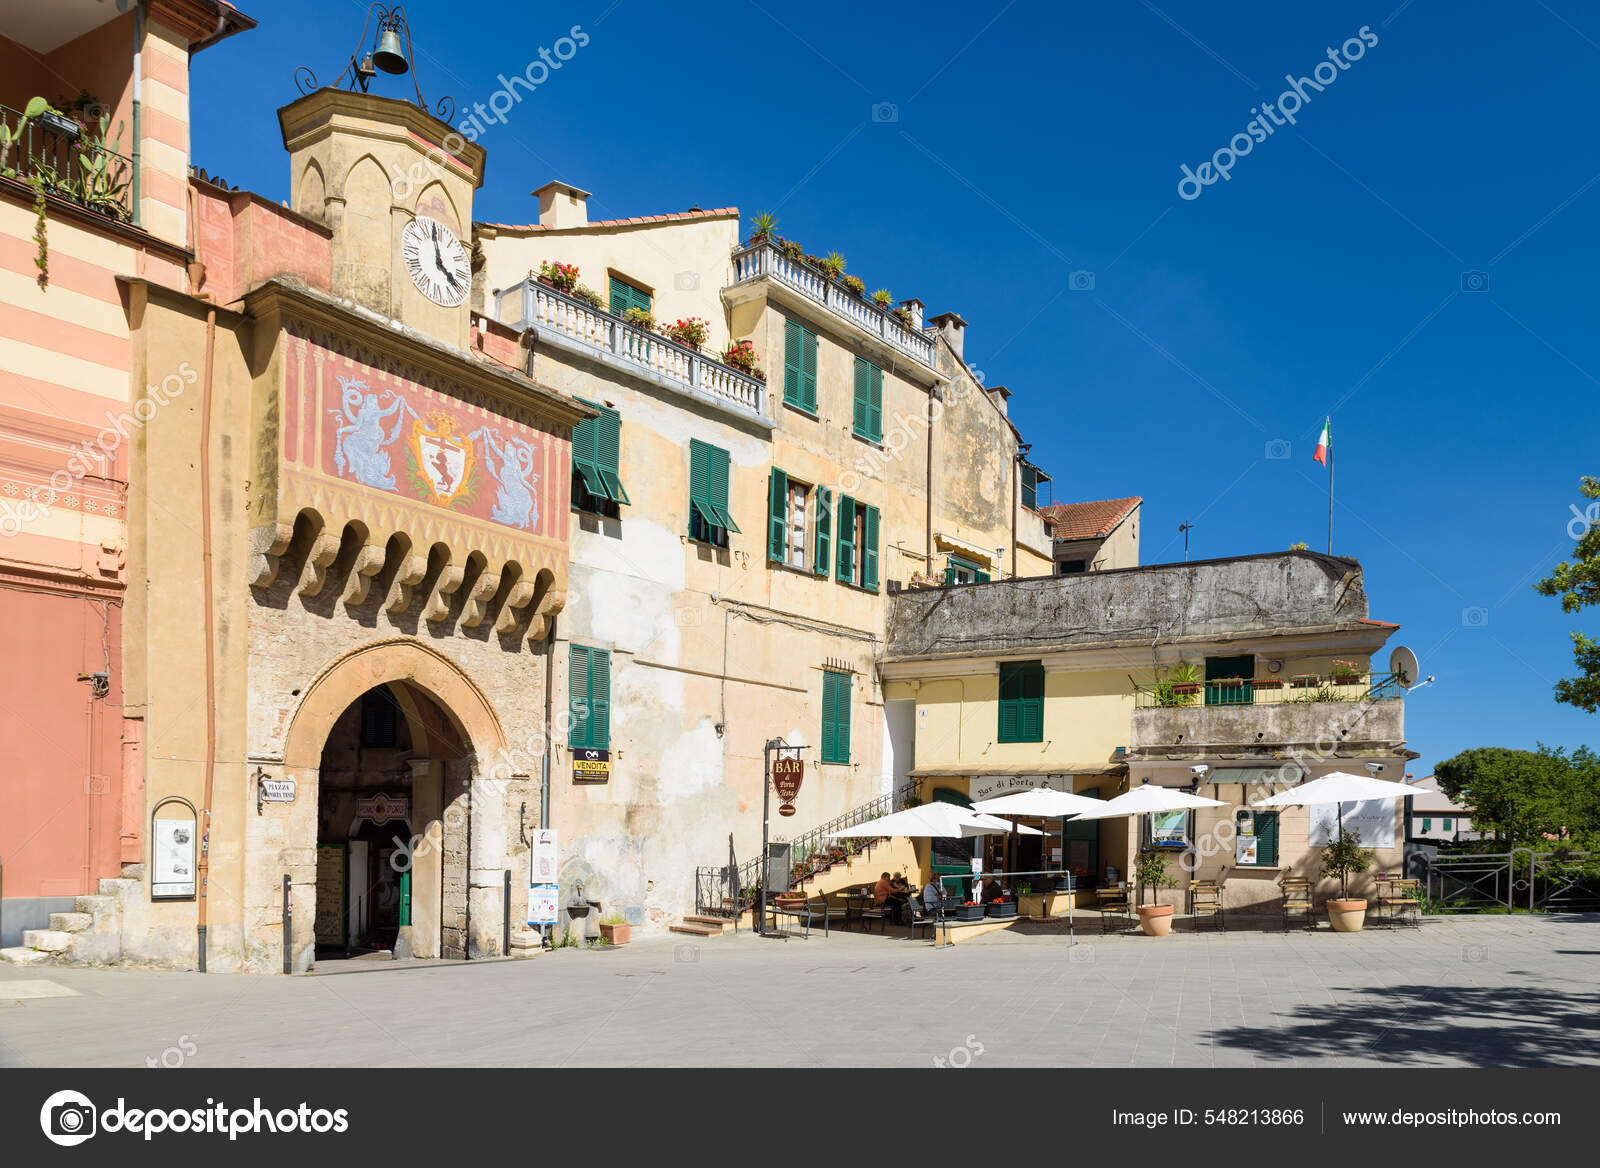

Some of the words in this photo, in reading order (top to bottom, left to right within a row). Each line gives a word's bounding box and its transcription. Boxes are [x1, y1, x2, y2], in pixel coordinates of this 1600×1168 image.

[575, 761, 608, 770] VENDITA
[775, 760, 801, 773] BAR
[977, 786, 993, 797] Bar
[996, 780, 1005, 789] di
[1009, 778, 1034, 788] Porta
